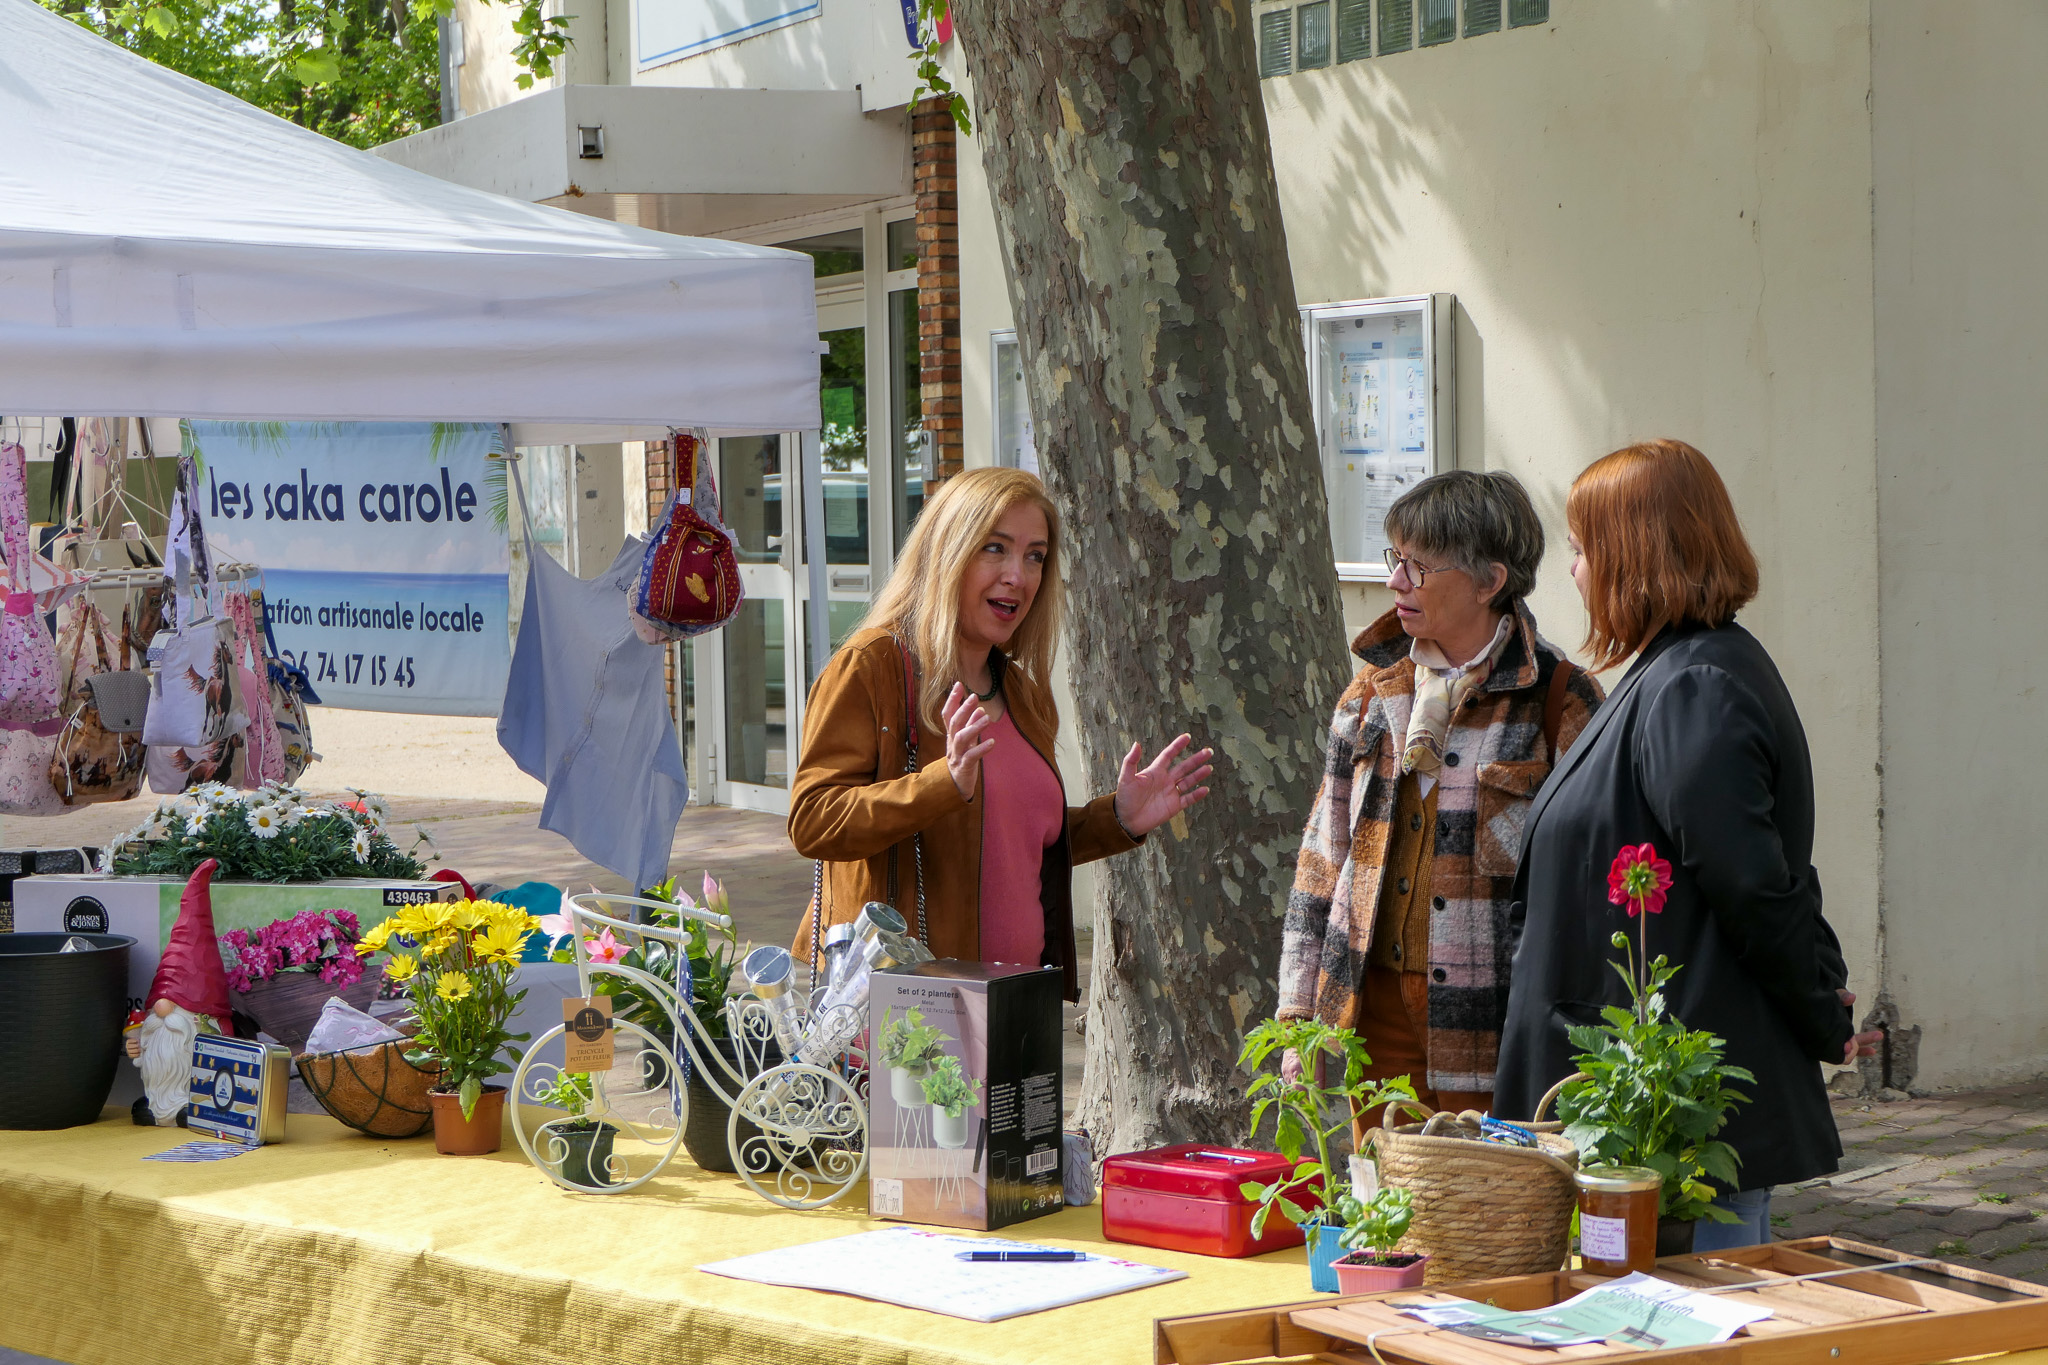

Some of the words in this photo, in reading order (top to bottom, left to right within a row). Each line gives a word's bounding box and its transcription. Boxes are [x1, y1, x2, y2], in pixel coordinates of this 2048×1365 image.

[209, 466, 254, 521] les
[263, 467, 345, 522] saka
[358, 466, 477, 523] carole
[317, 601, 415, 630] artisanale
[419, 602, 484, 632] locale
[317, 651, 338, 683] 74
[345, 653, 364, 685] 17
[371, 654, 387, 687] 15
[393, 655, 416, 689] 45
[387, 891, 432, 904] 439463
[75, 914, 101, 922] MASON
[897, 987, 910, 996] Set
[911, 988, 920, 996] of
[928, 990, 960, 999] planters
[593, 1053, 612, 1061] FLEUR
